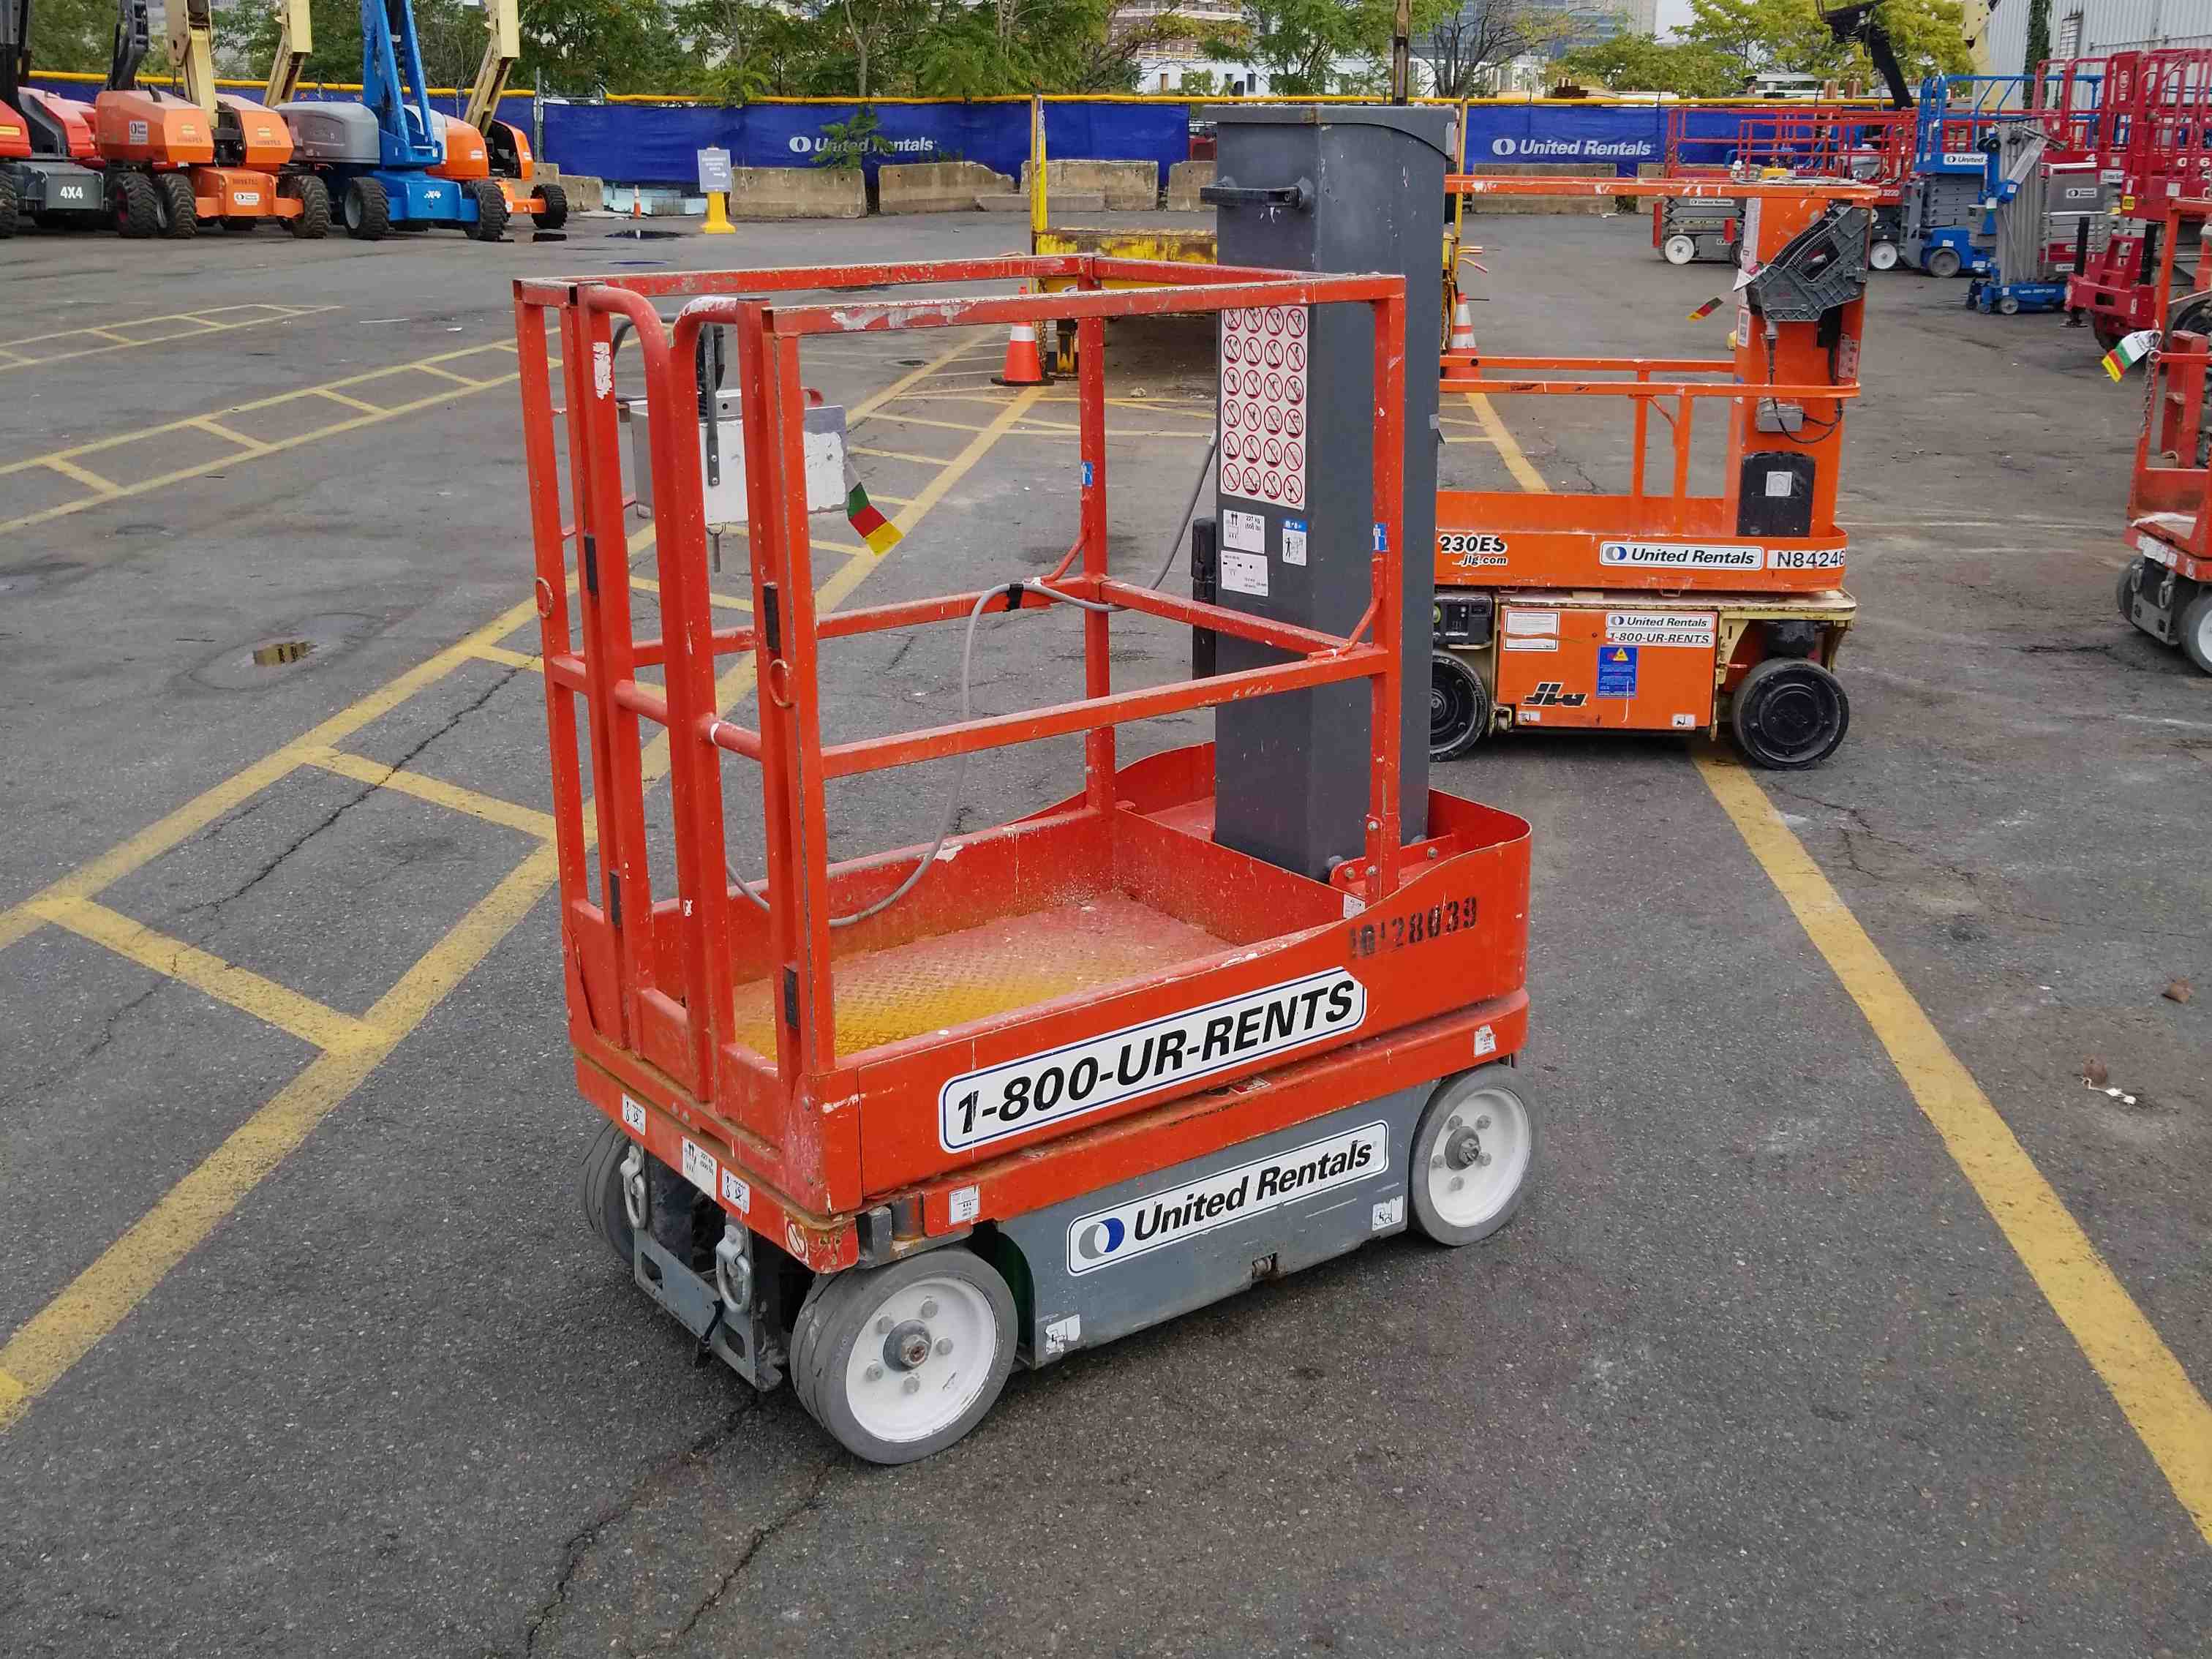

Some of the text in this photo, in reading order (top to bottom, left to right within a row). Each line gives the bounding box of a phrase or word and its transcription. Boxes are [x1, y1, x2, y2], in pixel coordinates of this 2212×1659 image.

[872, 136, 934, 152] ntals
[1520, 139, 1652, 156] United Rentals
[60, 187, 83, 199] 4X4
[1439, 535, 1506, 553] 230ES
[1631, 548, 1754, 565] United Rentals
[1627, 617, 1707, 628] United Rentals
[1610, 632, 1709, 644] 1-800-UR-RENTS
[957, 979, 1355, 1135] 1-800-UR-RENTS
[1134, 1139, 1372, 1241] United Rentals
